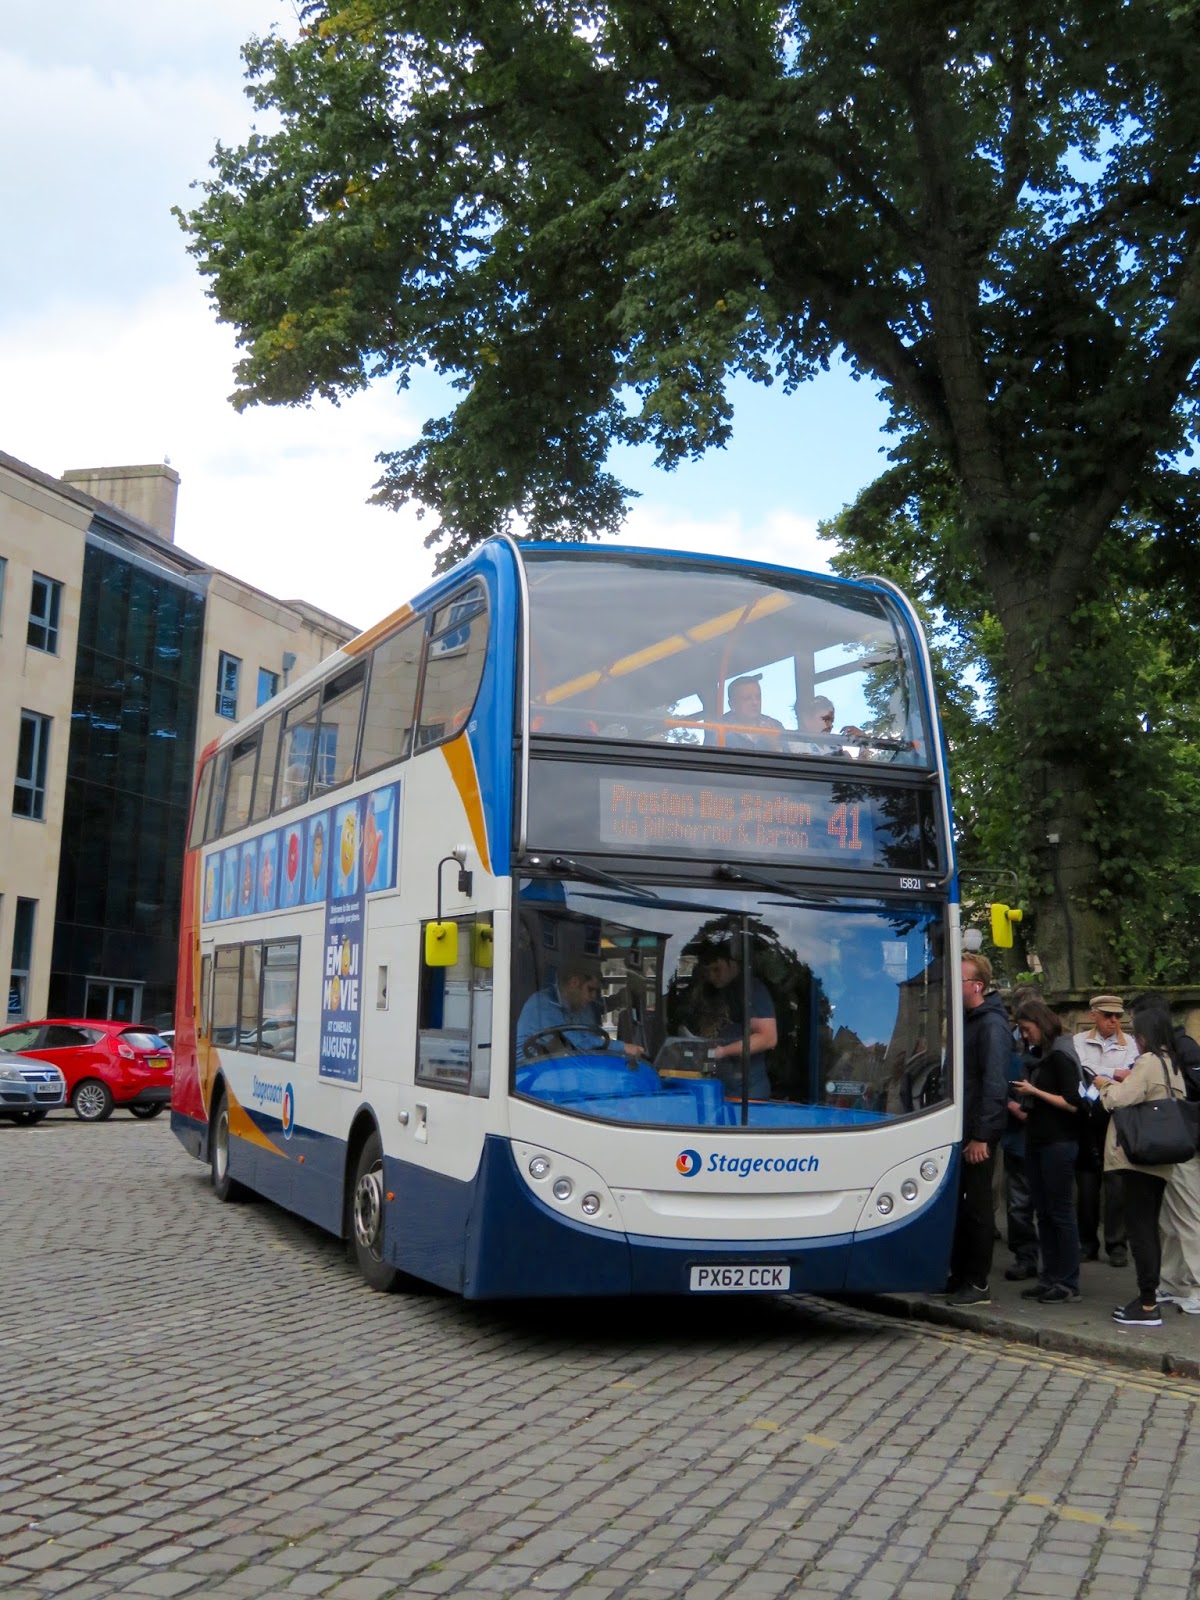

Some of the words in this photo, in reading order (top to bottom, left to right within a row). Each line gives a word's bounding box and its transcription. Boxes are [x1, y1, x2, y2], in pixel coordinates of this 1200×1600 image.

[612, 784, 695, 818] Preston
[700, 790, 735, 820] Bus
[741, 792, 812, 826] Station
[827, 802, 862, 850] 41
[900, 877, 921, 890] 15821
[322, 1035, 351, 1060] AUGUST
[351, 1038, 357, 1060] 2
[252, 1074, 283, 1106] Stagecoach
[707, 1153, 819, 1178] Stagecoach
[698, 1269, 744, 1287] PX62
[749, 1269, 783, 1286] CCK
